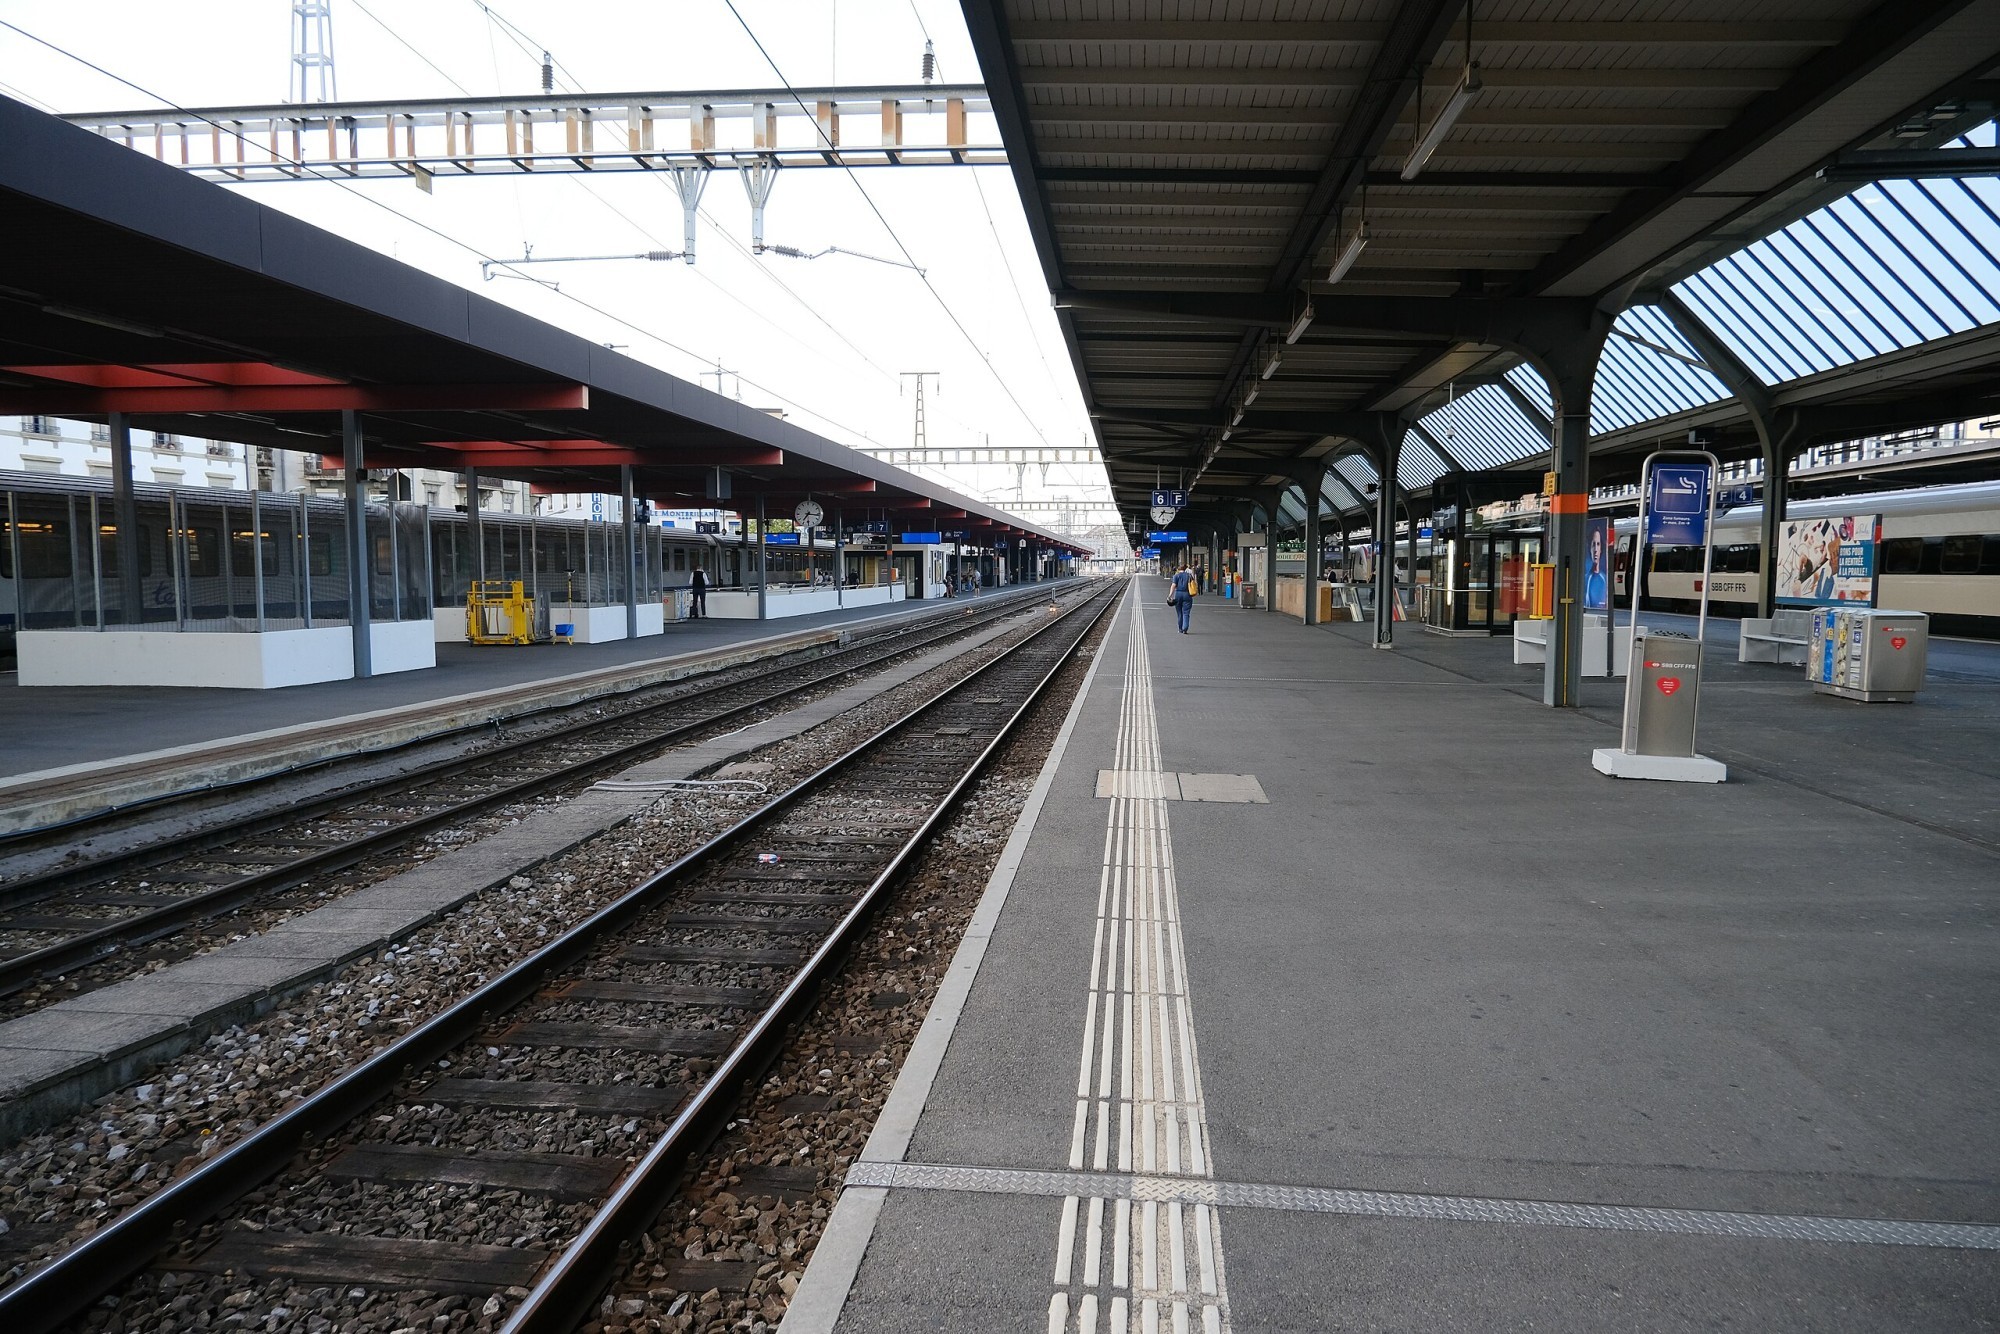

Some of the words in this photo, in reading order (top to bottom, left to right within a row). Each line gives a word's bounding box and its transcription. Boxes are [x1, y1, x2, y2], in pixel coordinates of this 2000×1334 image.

[1157, 494, 1164, 504] 6
[1175, 494, 1182, 504] F
[1720, 491, 1728, 501] F
[1739, 490, 1747, 501] 4
[1852, 546, 1864, 556] POUR
[1838, 557, 1845, 566] LA
[1711, 582, 1723, 592] SBB
[1723, 583, 1735, 592] CFF
[1735, 583, 1747, 593] FFS
